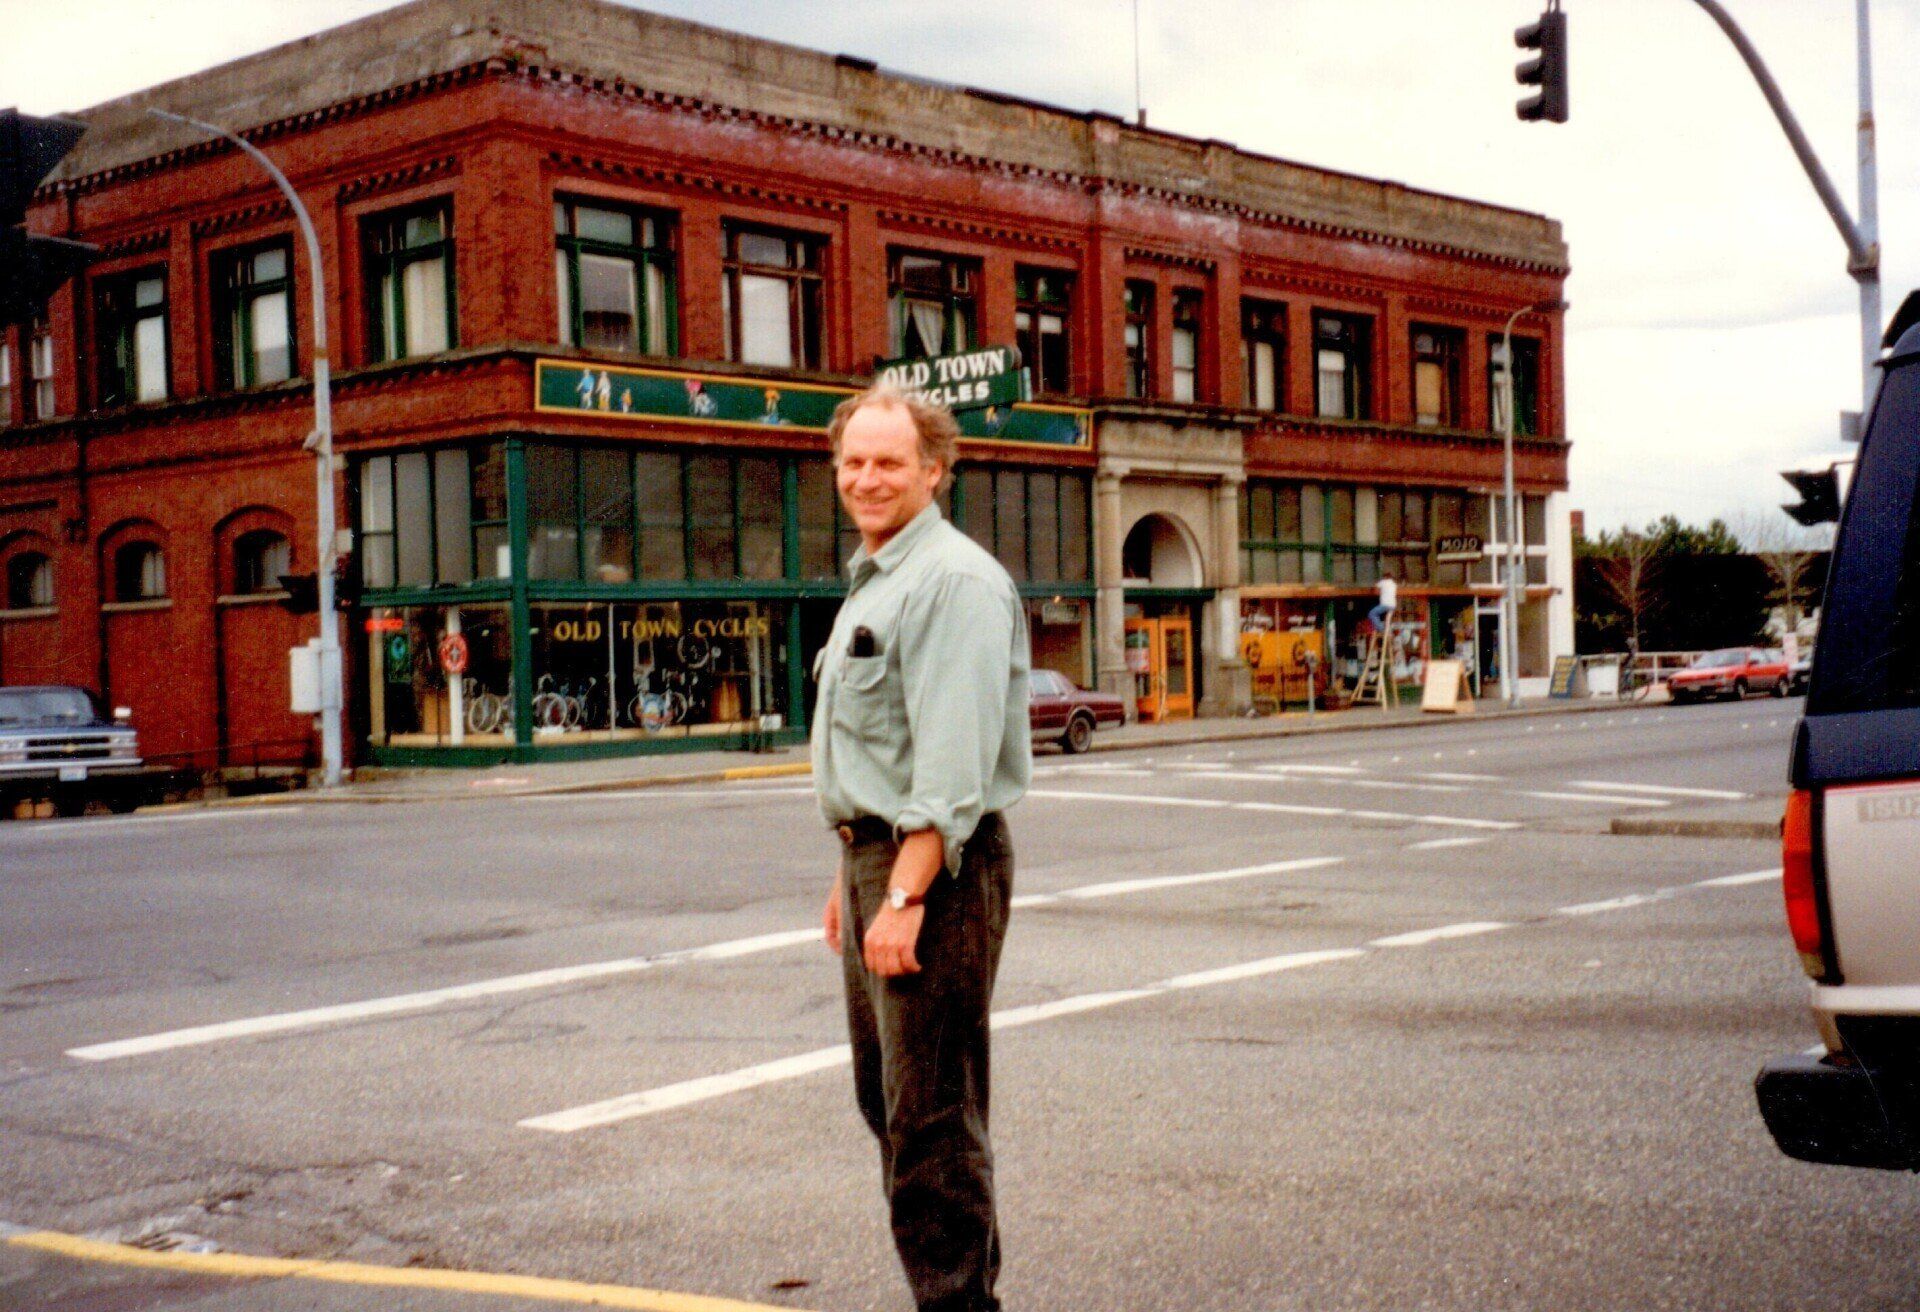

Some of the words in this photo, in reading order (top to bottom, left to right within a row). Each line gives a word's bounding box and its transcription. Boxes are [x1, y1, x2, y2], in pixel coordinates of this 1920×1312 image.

[881, 362, 930, 387] OLD
[934, 349, 1005, 383] TOWN
[1441, 537, 1478, 551] MOJO
[554, 620, 601, 641] OLD
[619, 617, 680, 640] TOWN
[693, 617, 770, 639] CYCLES
